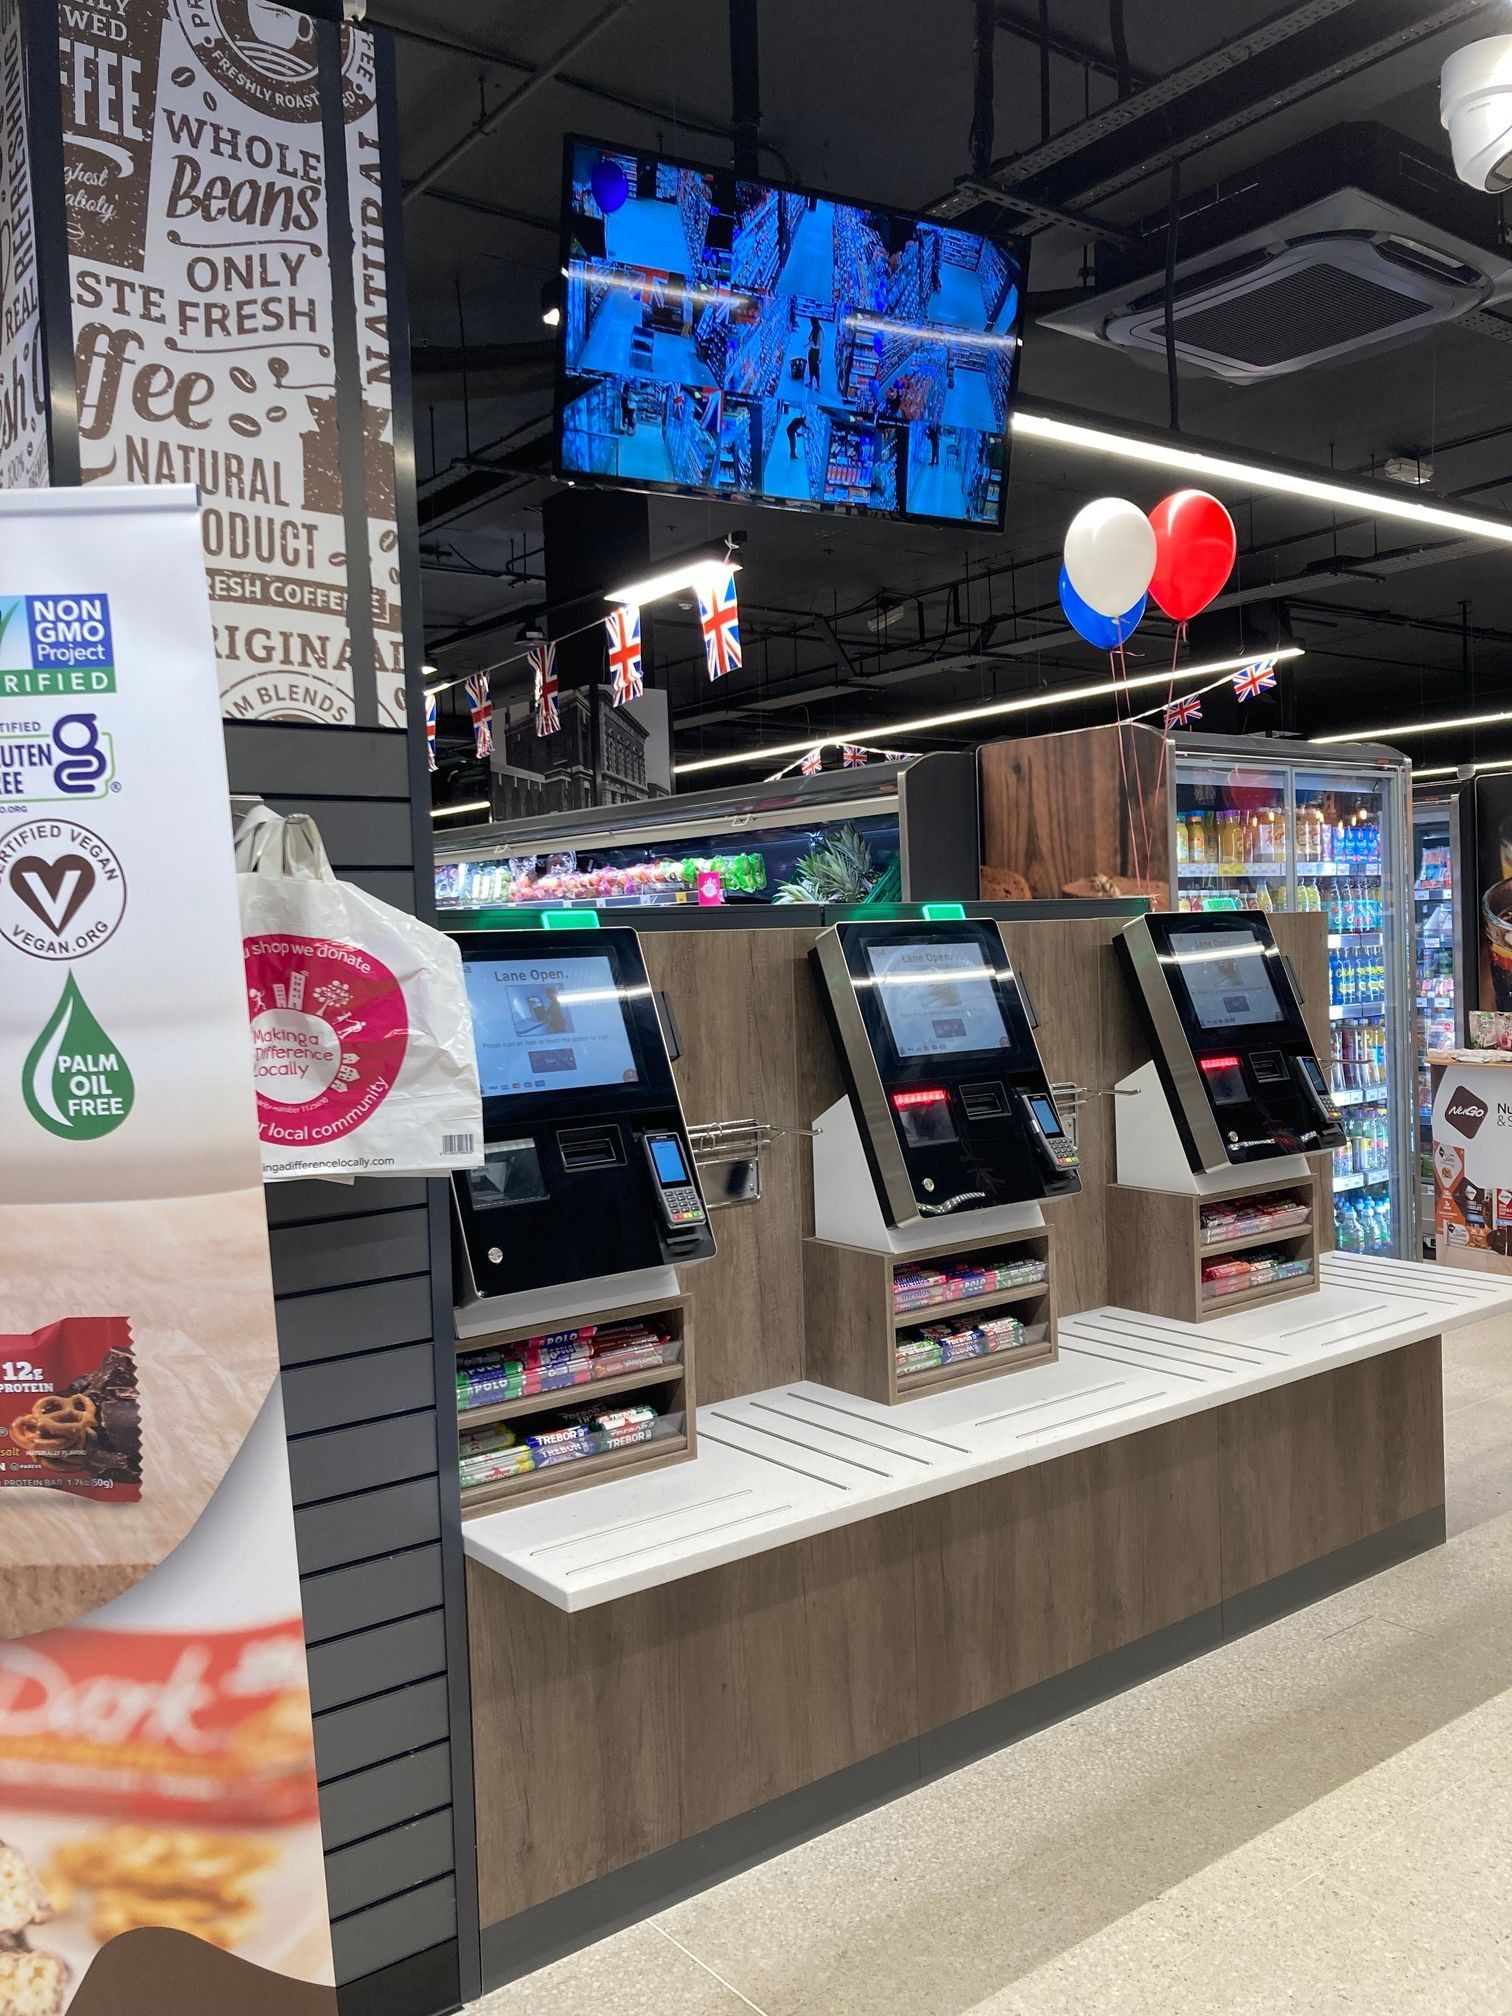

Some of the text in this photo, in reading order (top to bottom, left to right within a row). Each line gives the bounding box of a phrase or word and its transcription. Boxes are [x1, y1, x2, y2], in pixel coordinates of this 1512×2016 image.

[61, 4, 128, 42] WED
[211, 50, 273, 102] FRESHLY
[4, 30, 34, 285] REFRESHING
[162, 108, 323, 185] WHOLE
[166, 154, 321, 232] Beans
[187, 252, 306, 292] ONLY
[75, 270, 167, 324] STE
[5, 276, 38, 346] REAL
[178, 296, 318, 338] FRESH
[126, 434, 291, 508] NATURAL
[202, 507, 319, 569] ODUCT
[33, 599, 103, 622] NON
[35, 620, 106, 644] GMO
[37, 644, 106, 666] Project
[4, 671, 109, 693] RIFIED
[257, 683, 349, 723] BLENDS
[0, 743, 53, 769] UTEN
[69, 828, 119, 881] VEGAN
[12, 919, 109, 955] VEGAN.ORG
[251, 939, 290, 957] shop
[292, 943, 314, 956] we
[316, 943, 372, 974] donate
[901, 953, 924, 964] Lane
[494, 969, 569, 982] Lane Open.
[253, 1028, 308, 1047] Making
[58, 1054, 119, 1073] PALM
[255, 1046, 334, 1062] Difference
[69, 1075, 113, 1096] OIL
[68, 1097, 125, 1116] FREE
[268, 1122, 308, 1140] local
[312, 1077, 390, 1139] community
[1448, 1105, 1485, 1119] NuGo
[262, 1157, 395, 1174] ingadifferencelocally.com
[547, 1333, 578, 1345] POLO
[2, 1361, 43, 1381] 12g
[536, 1431, 577, 1446] TREBOR
[607, 1432, 645, 1450] TREBOR
